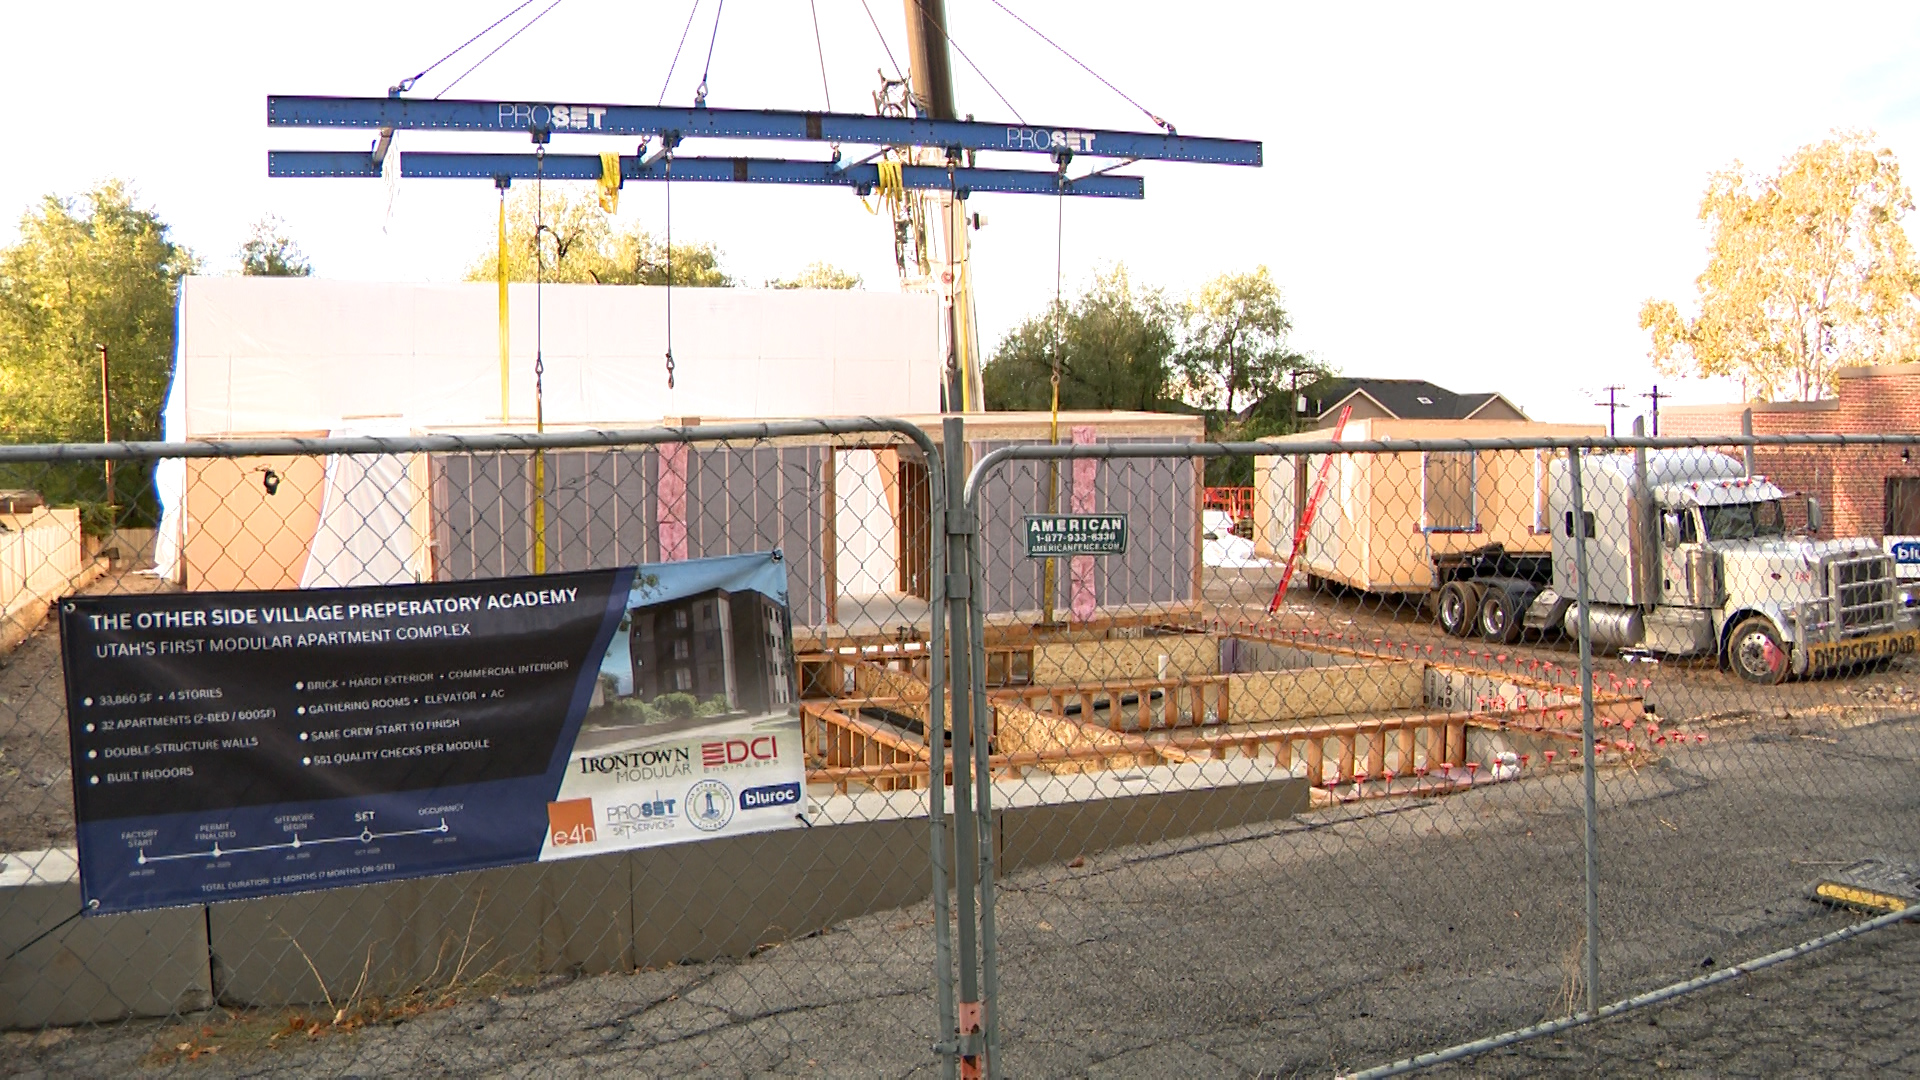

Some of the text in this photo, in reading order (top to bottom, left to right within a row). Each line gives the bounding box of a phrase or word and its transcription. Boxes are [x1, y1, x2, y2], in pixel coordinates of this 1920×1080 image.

[498, 103, 607, 128] PROSET
[1006, 126, 1096, 152] PROSET
[1030, 518, 1122, 532] AMERICAN
[1031, 542, 1120, 552] AMERICANFENCE.COM
[89, 587, 578, 631] THE OTHER SIDE VILLAGE PREPERATORY ACADEMY
[96, 623, 472, 658] UTAH'S FIRST MODULAR APARTMENT COMPLEX
[1882, 635, 1915, 654] LOAD
[307, 659, 569, 690] BRICK HARDI EXTERIOR COMMERCIAL INTERIORS
[138, 692, 153, 704] SF
[168, 691, 176, 701] 4
[177, 687, 224, 700] STORIES
[308, 689, 505, 715] GATHERING ROOMS ELEVATOR AC
[116, 715, 191, 730] APARTMENTS
[310, 717, 461, 742] SAME CREW START TO FINISH
[104, 736, 259, 758] DOUBLE-STRUCTURE WALLS
[333, 750, 378, 764] QUALITY
[380, 745, 423, 759] CHECKS
[424, 742, 445, 755] PER
[446, 738, 490, 751] MODULE
[580, 747, 690, 774] IRONTOWN
[106, 765, 195, 784] BUILT INDOORS
[616, 763, 692, 784] MODULAR
[744, 787, 796, 806] bluroc
[354, 811, 376, 823] SET
[417, 803, 465, 817] OCCUPANCY
[606, 798, 677, 821] PROSET
[121, 829, 159, 841] FACTORY
[194, 830, 237, 841] FINALIZED
[199, 821, 231, 832] PERMIT
[282, 822, 308, 832] BEGIN
[552, 822, 597, 845] e4h
[631, 819, 676, 834] SERVICES
[127, 838, 153, 848] START
[201, 881, 227, 892] TOTAL
[283, 872, 318, 883] MONTHS
[326, 867, 361, 878] MONTHS
